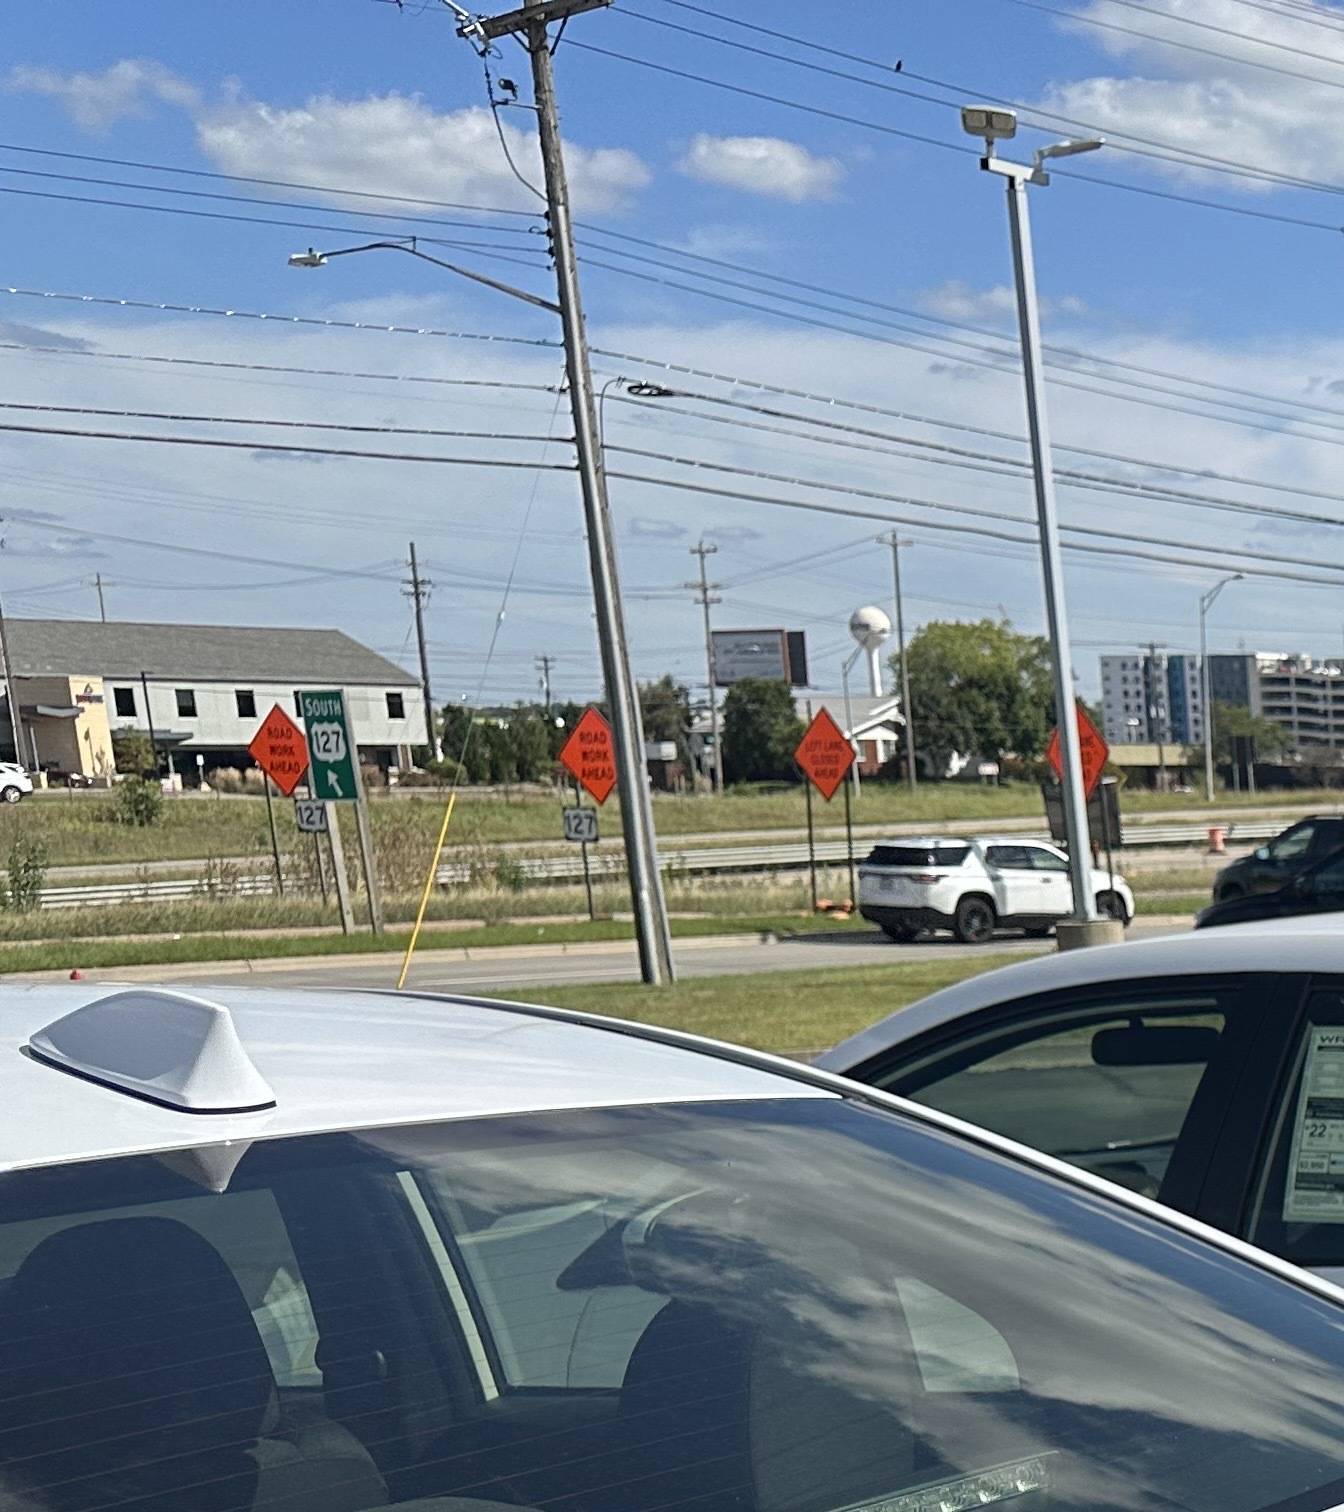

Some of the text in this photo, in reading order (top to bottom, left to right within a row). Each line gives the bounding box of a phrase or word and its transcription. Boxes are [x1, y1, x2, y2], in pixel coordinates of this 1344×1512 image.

[305, 697, 342, 717] SOUTH
[267, 727, 293, 740] ROAD
[580, 731, 607, 744] ROAD
[313, 730, 340, 753] 127
[269, 744, 295, 757] WORK
[582, 750, 609, 762] WORK
[269, 761, 300, 775] AHEAD
[581, 766, 614, 780] AHEAD
[297, 805, 325, 826] 127
[566, 814, 594, 835] 127
[1309, 1124, 1327, 1138] 22
